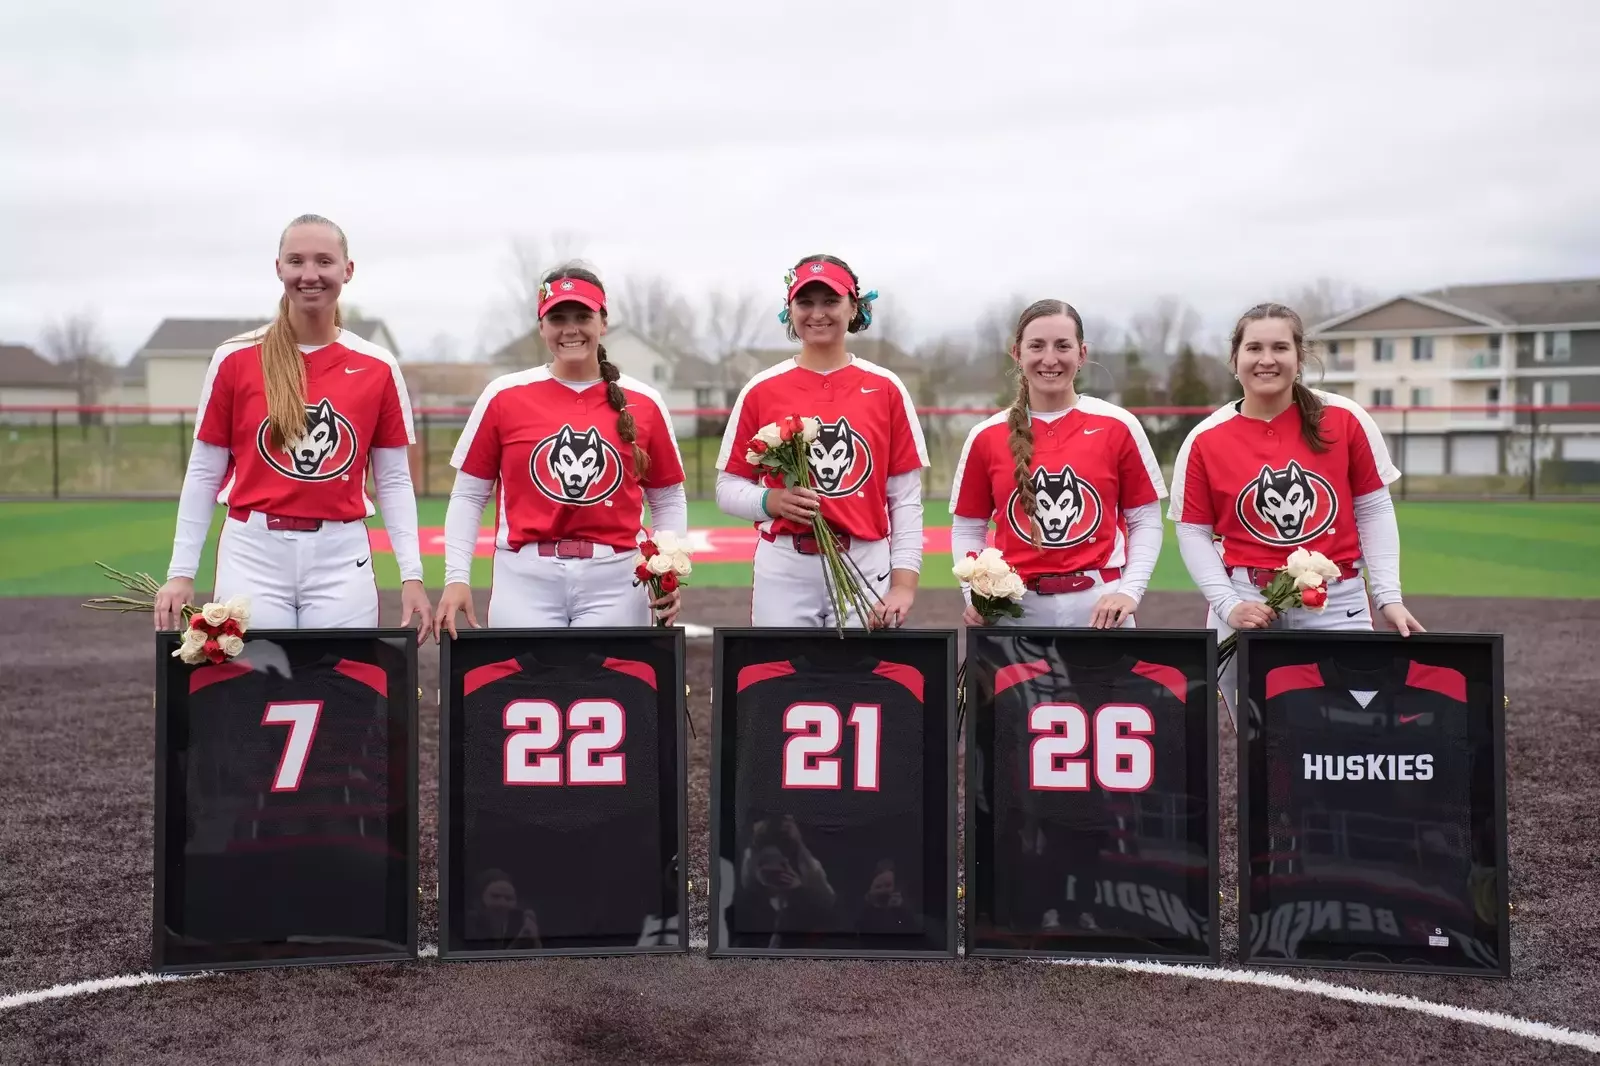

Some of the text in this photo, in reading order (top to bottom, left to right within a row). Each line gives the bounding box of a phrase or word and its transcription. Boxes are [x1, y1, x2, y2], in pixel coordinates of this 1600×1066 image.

[260, 699, 324, 793] 7
[502, 698, 627, 787] 22
[781, 701, 882, 792] 21
[1027, 701, 1156, 793] 26
[1302, 753, 1434, 781] HUSKIES
